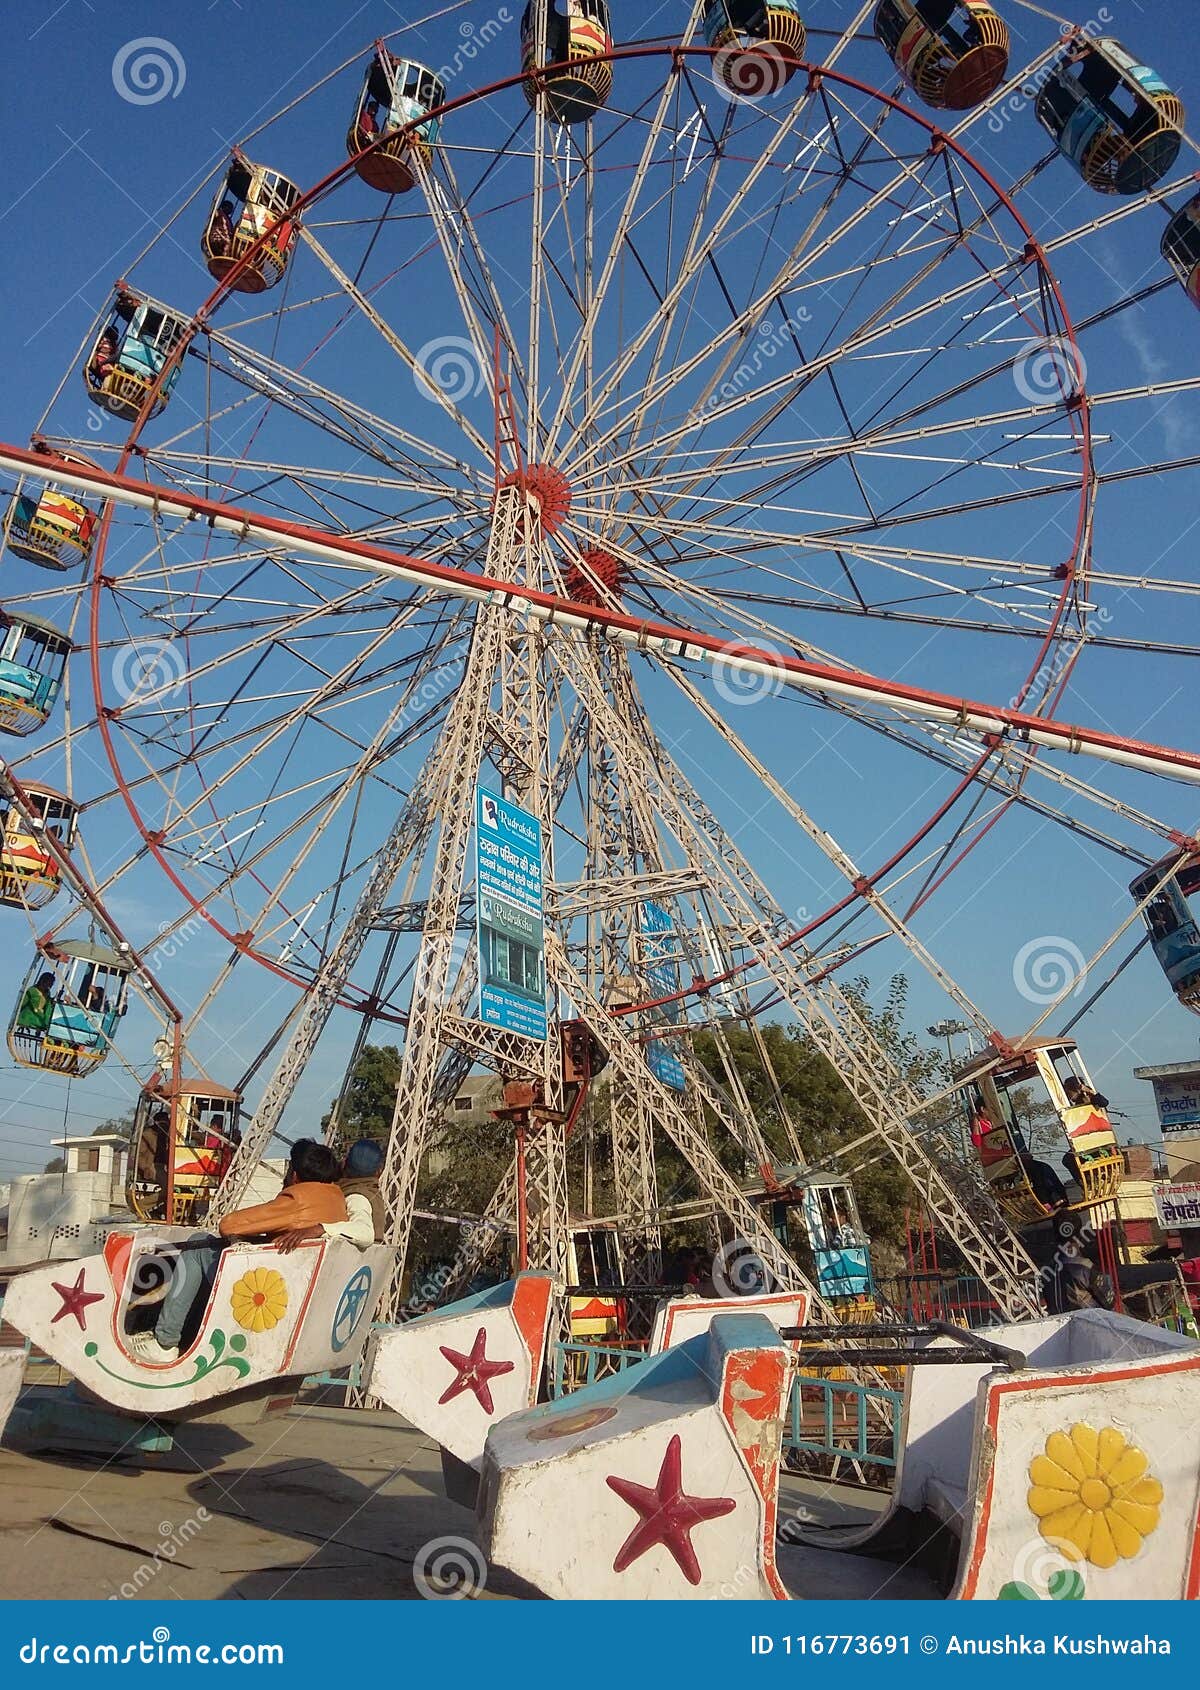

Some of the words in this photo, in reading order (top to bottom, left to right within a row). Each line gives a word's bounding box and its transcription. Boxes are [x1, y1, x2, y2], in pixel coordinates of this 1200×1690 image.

[499, 810, 537, 842] Rudraksha
[500, 845, 520, 868] परिवार
[520, 856, 529, 873] की
[1160, 1096, 1197, 1112] लैपटॉप
[1162, 1199, 1200, 1221] लैपटॉ
